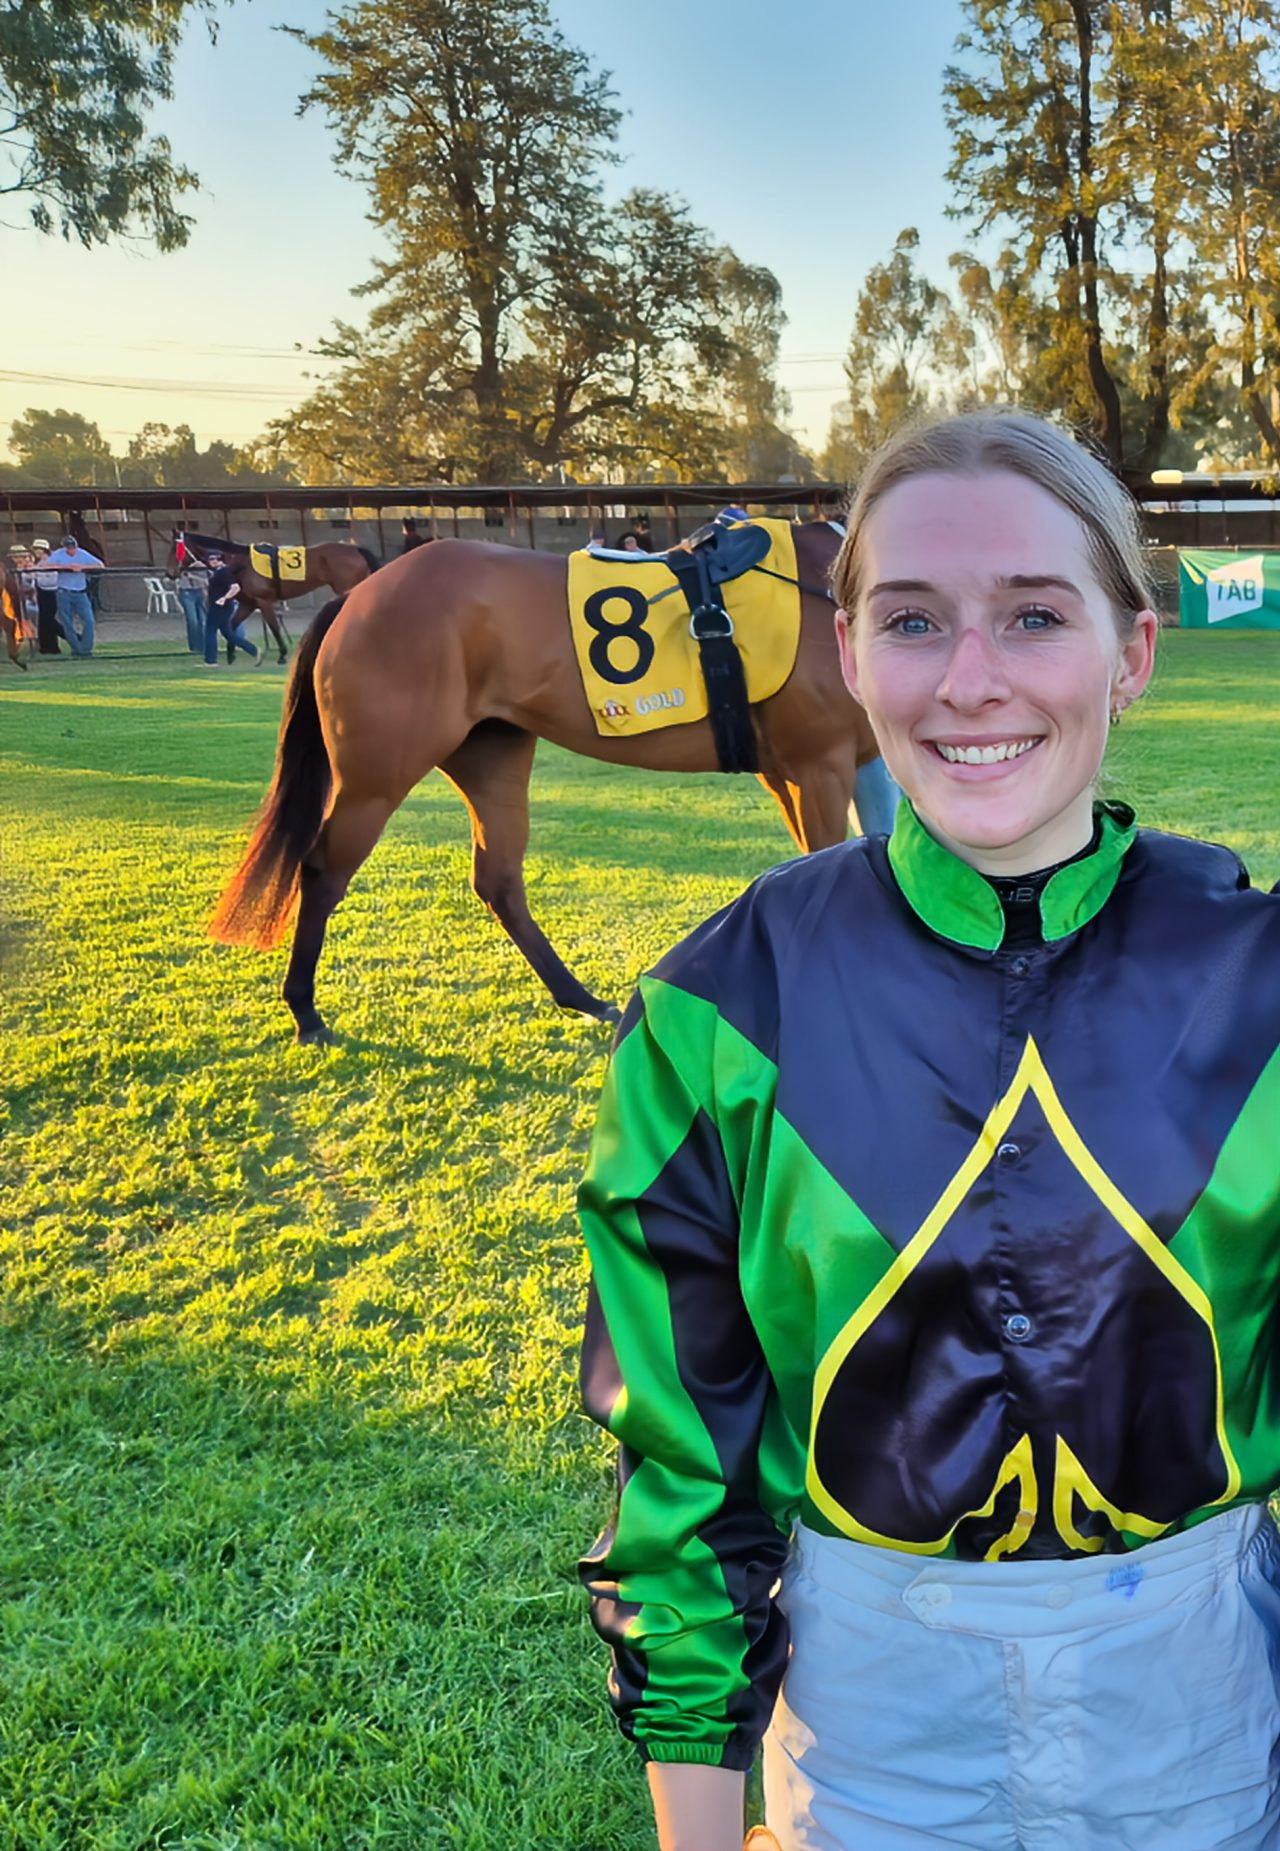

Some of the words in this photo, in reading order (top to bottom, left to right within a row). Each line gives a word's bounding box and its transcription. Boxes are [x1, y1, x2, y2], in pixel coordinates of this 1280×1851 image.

[286, 550, 302, 570] 3
[1216, 578, 1257, 602] TAB
[584, 586, 655, 685] 8
[636, 688, 686, 715] GOLD
